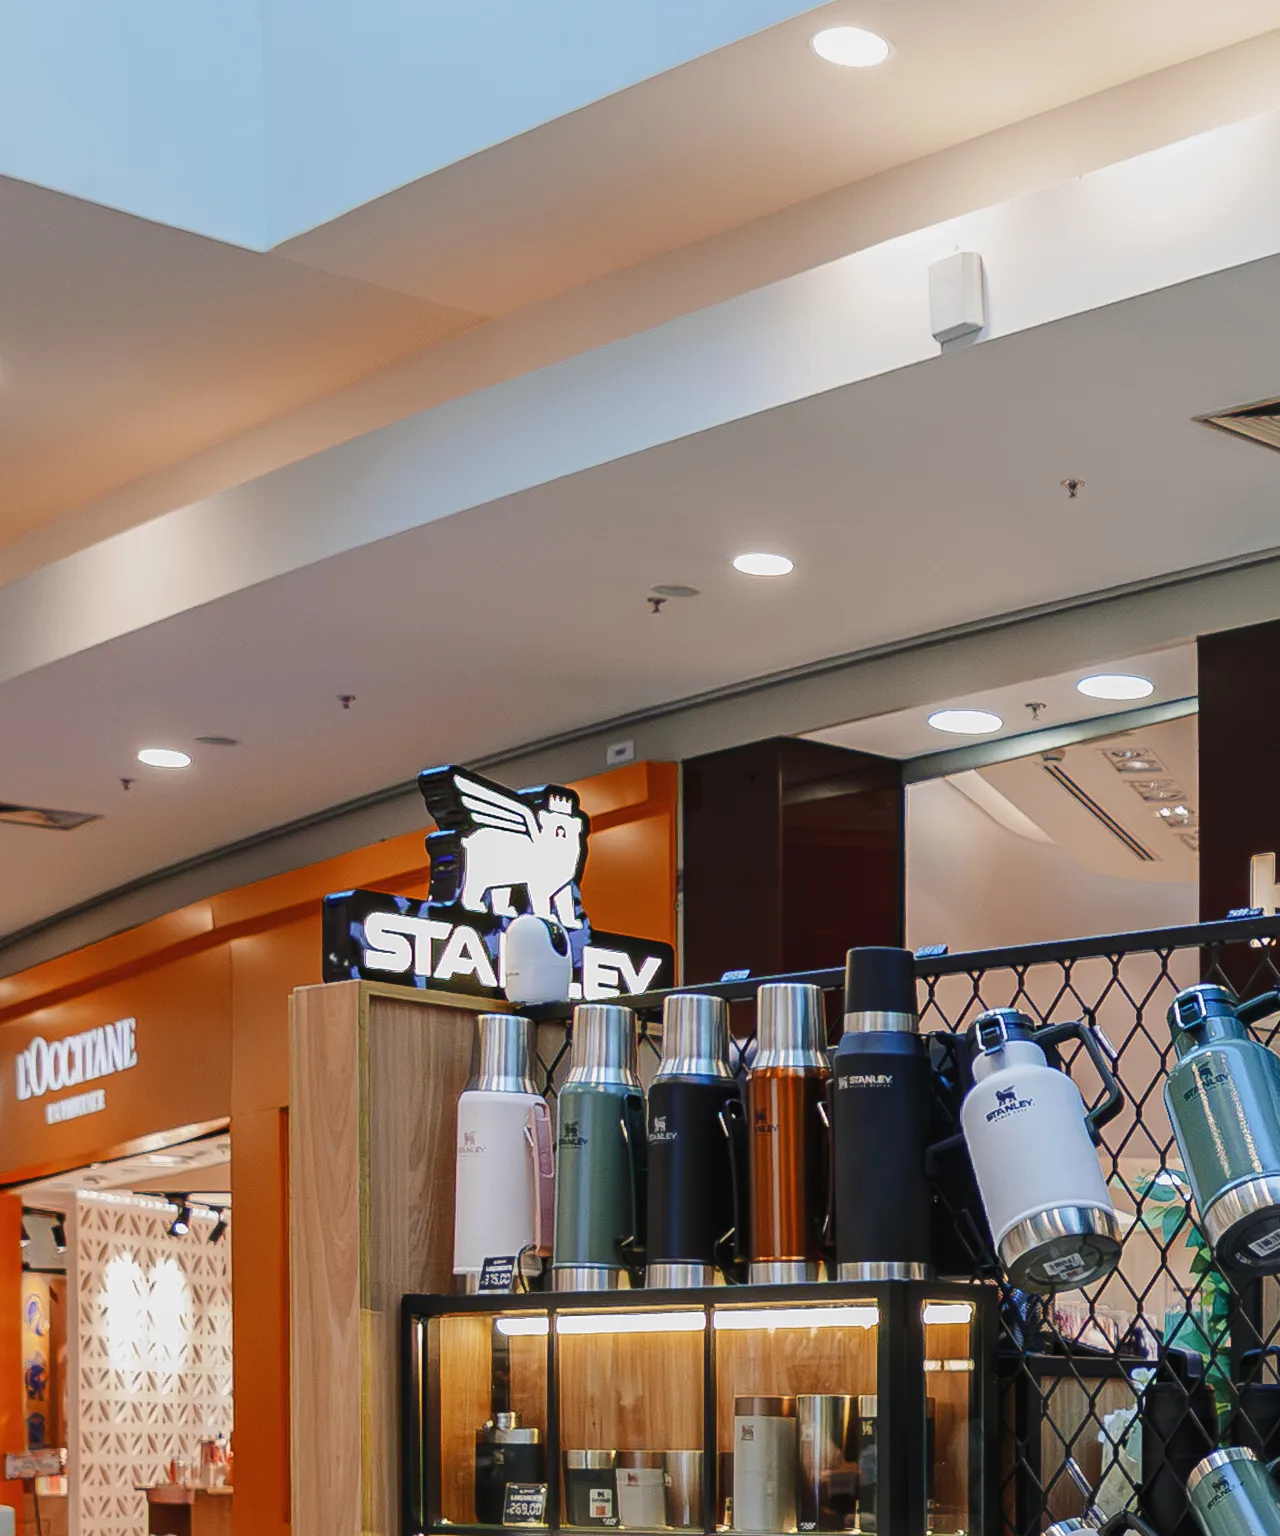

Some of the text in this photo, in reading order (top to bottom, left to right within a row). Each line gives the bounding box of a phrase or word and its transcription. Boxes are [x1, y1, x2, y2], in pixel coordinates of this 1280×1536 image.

[364, 911, 662, 1001] STAEY
[848, 1074, 893, 1084] STANLEY
[985, 1098, 1035, 1123] STANLEY
